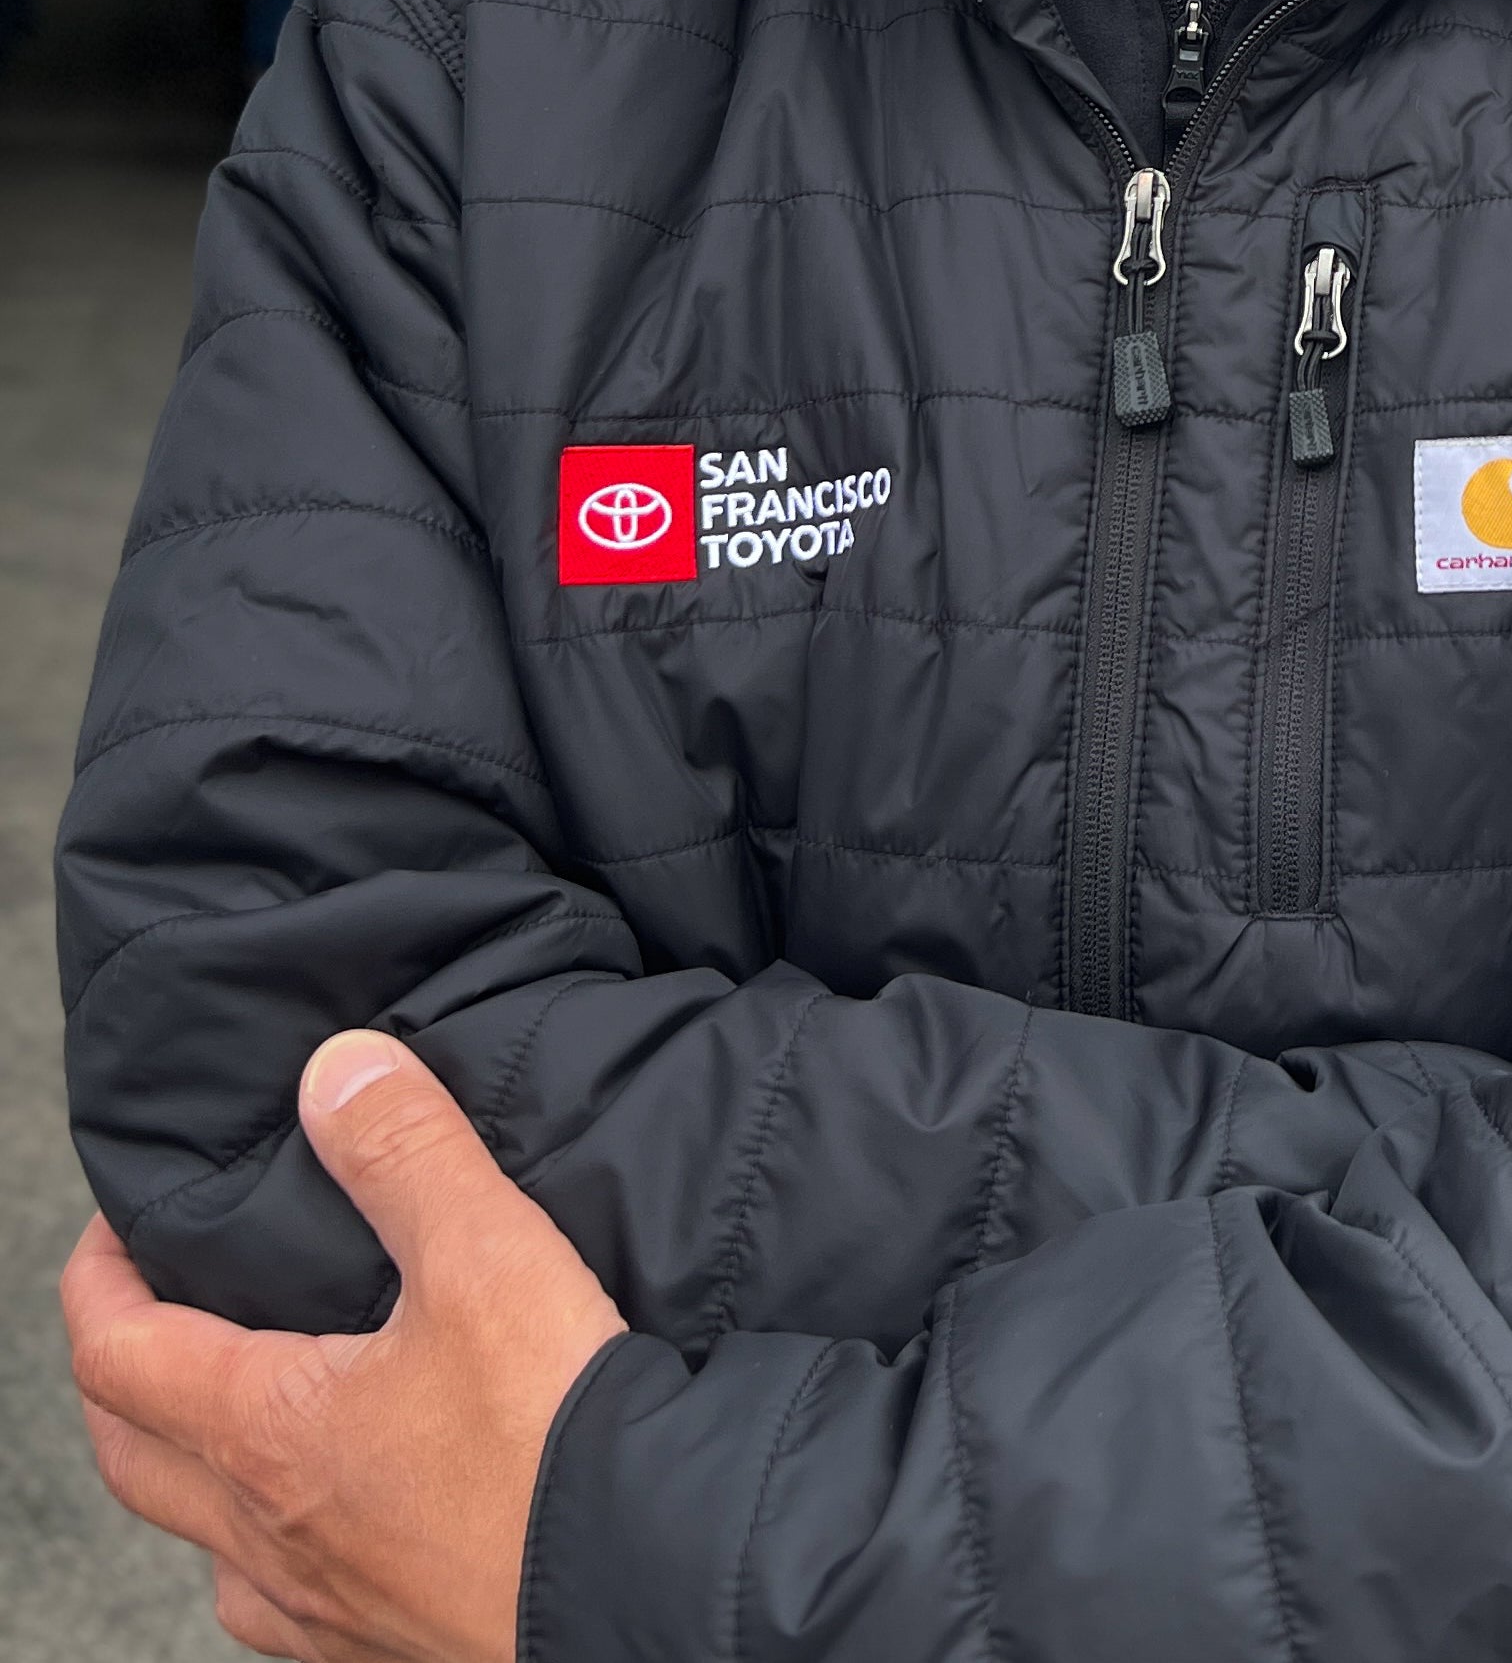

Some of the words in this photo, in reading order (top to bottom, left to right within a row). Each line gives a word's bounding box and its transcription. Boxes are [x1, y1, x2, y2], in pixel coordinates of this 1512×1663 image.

[700, 447, 788, 489] SAN
[701, 467, 892, 530] FRANCISCO
[700, 518, 855, 569] TOYOTA
